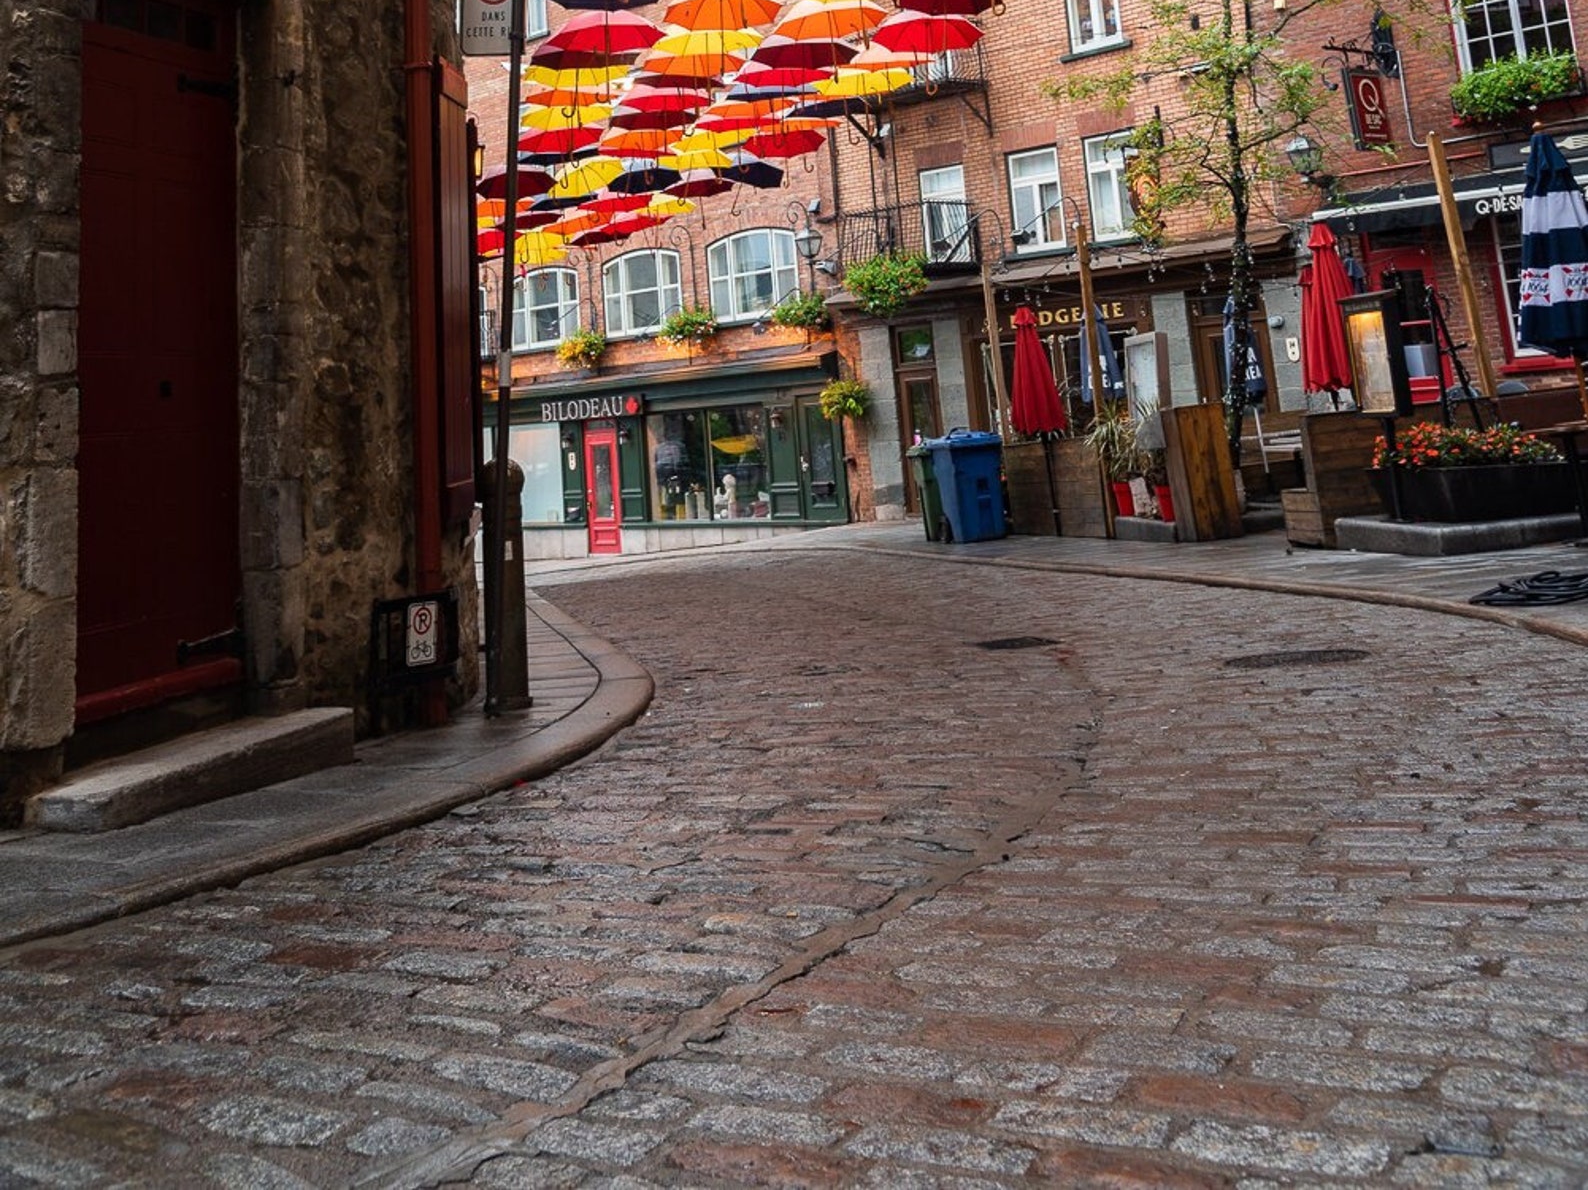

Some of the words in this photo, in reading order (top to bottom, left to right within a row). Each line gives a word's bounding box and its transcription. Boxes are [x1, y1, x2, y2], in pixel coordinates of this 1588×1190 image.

[481, 11, 506, 22] DANS
[465, 27, 494, 38] CETTE
[1359, 78, 1386, 120] Q
[541, 396, 623, 422] BILODEAU
